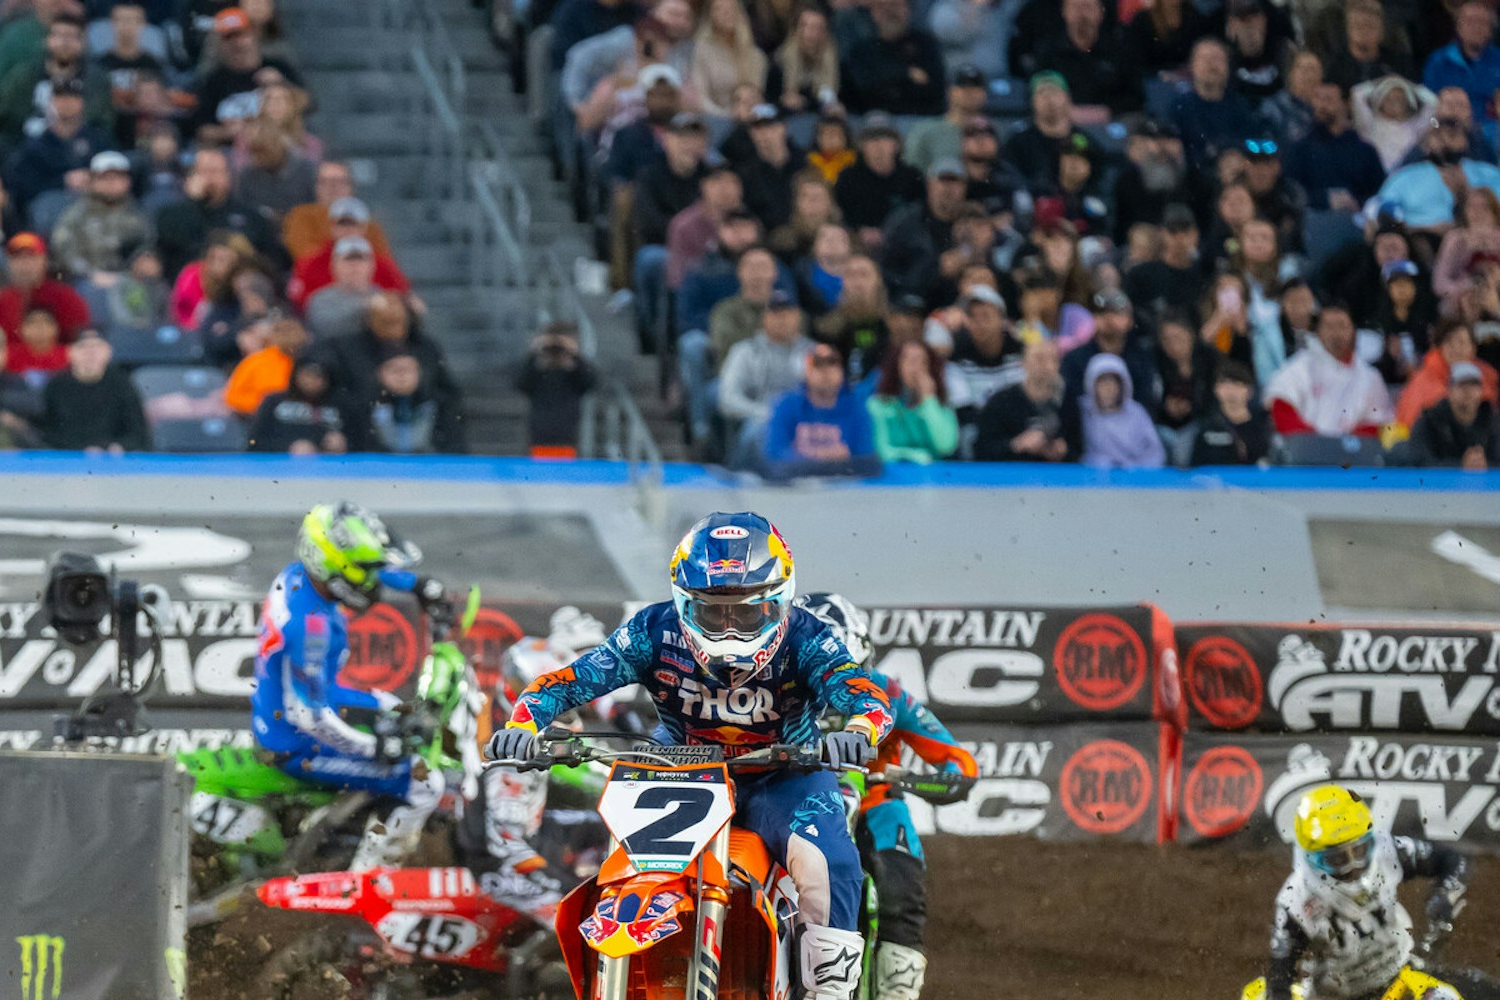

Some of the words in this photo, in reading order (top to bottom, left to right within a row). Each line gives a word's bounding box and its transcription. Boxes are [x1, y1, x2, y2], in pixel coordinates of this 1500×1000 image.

[869, 610, 1046, 649] UNTAIN
[1331, 629, 1478, 673] ROCKY
[678, 677, 781, 726] THOR
[1280, 673, 1495, 731] ATV
[1338, 736, 1484, 781] ROCKY
[621, 786, 715, 856] 2
[402, 917, 464, 954] 45
